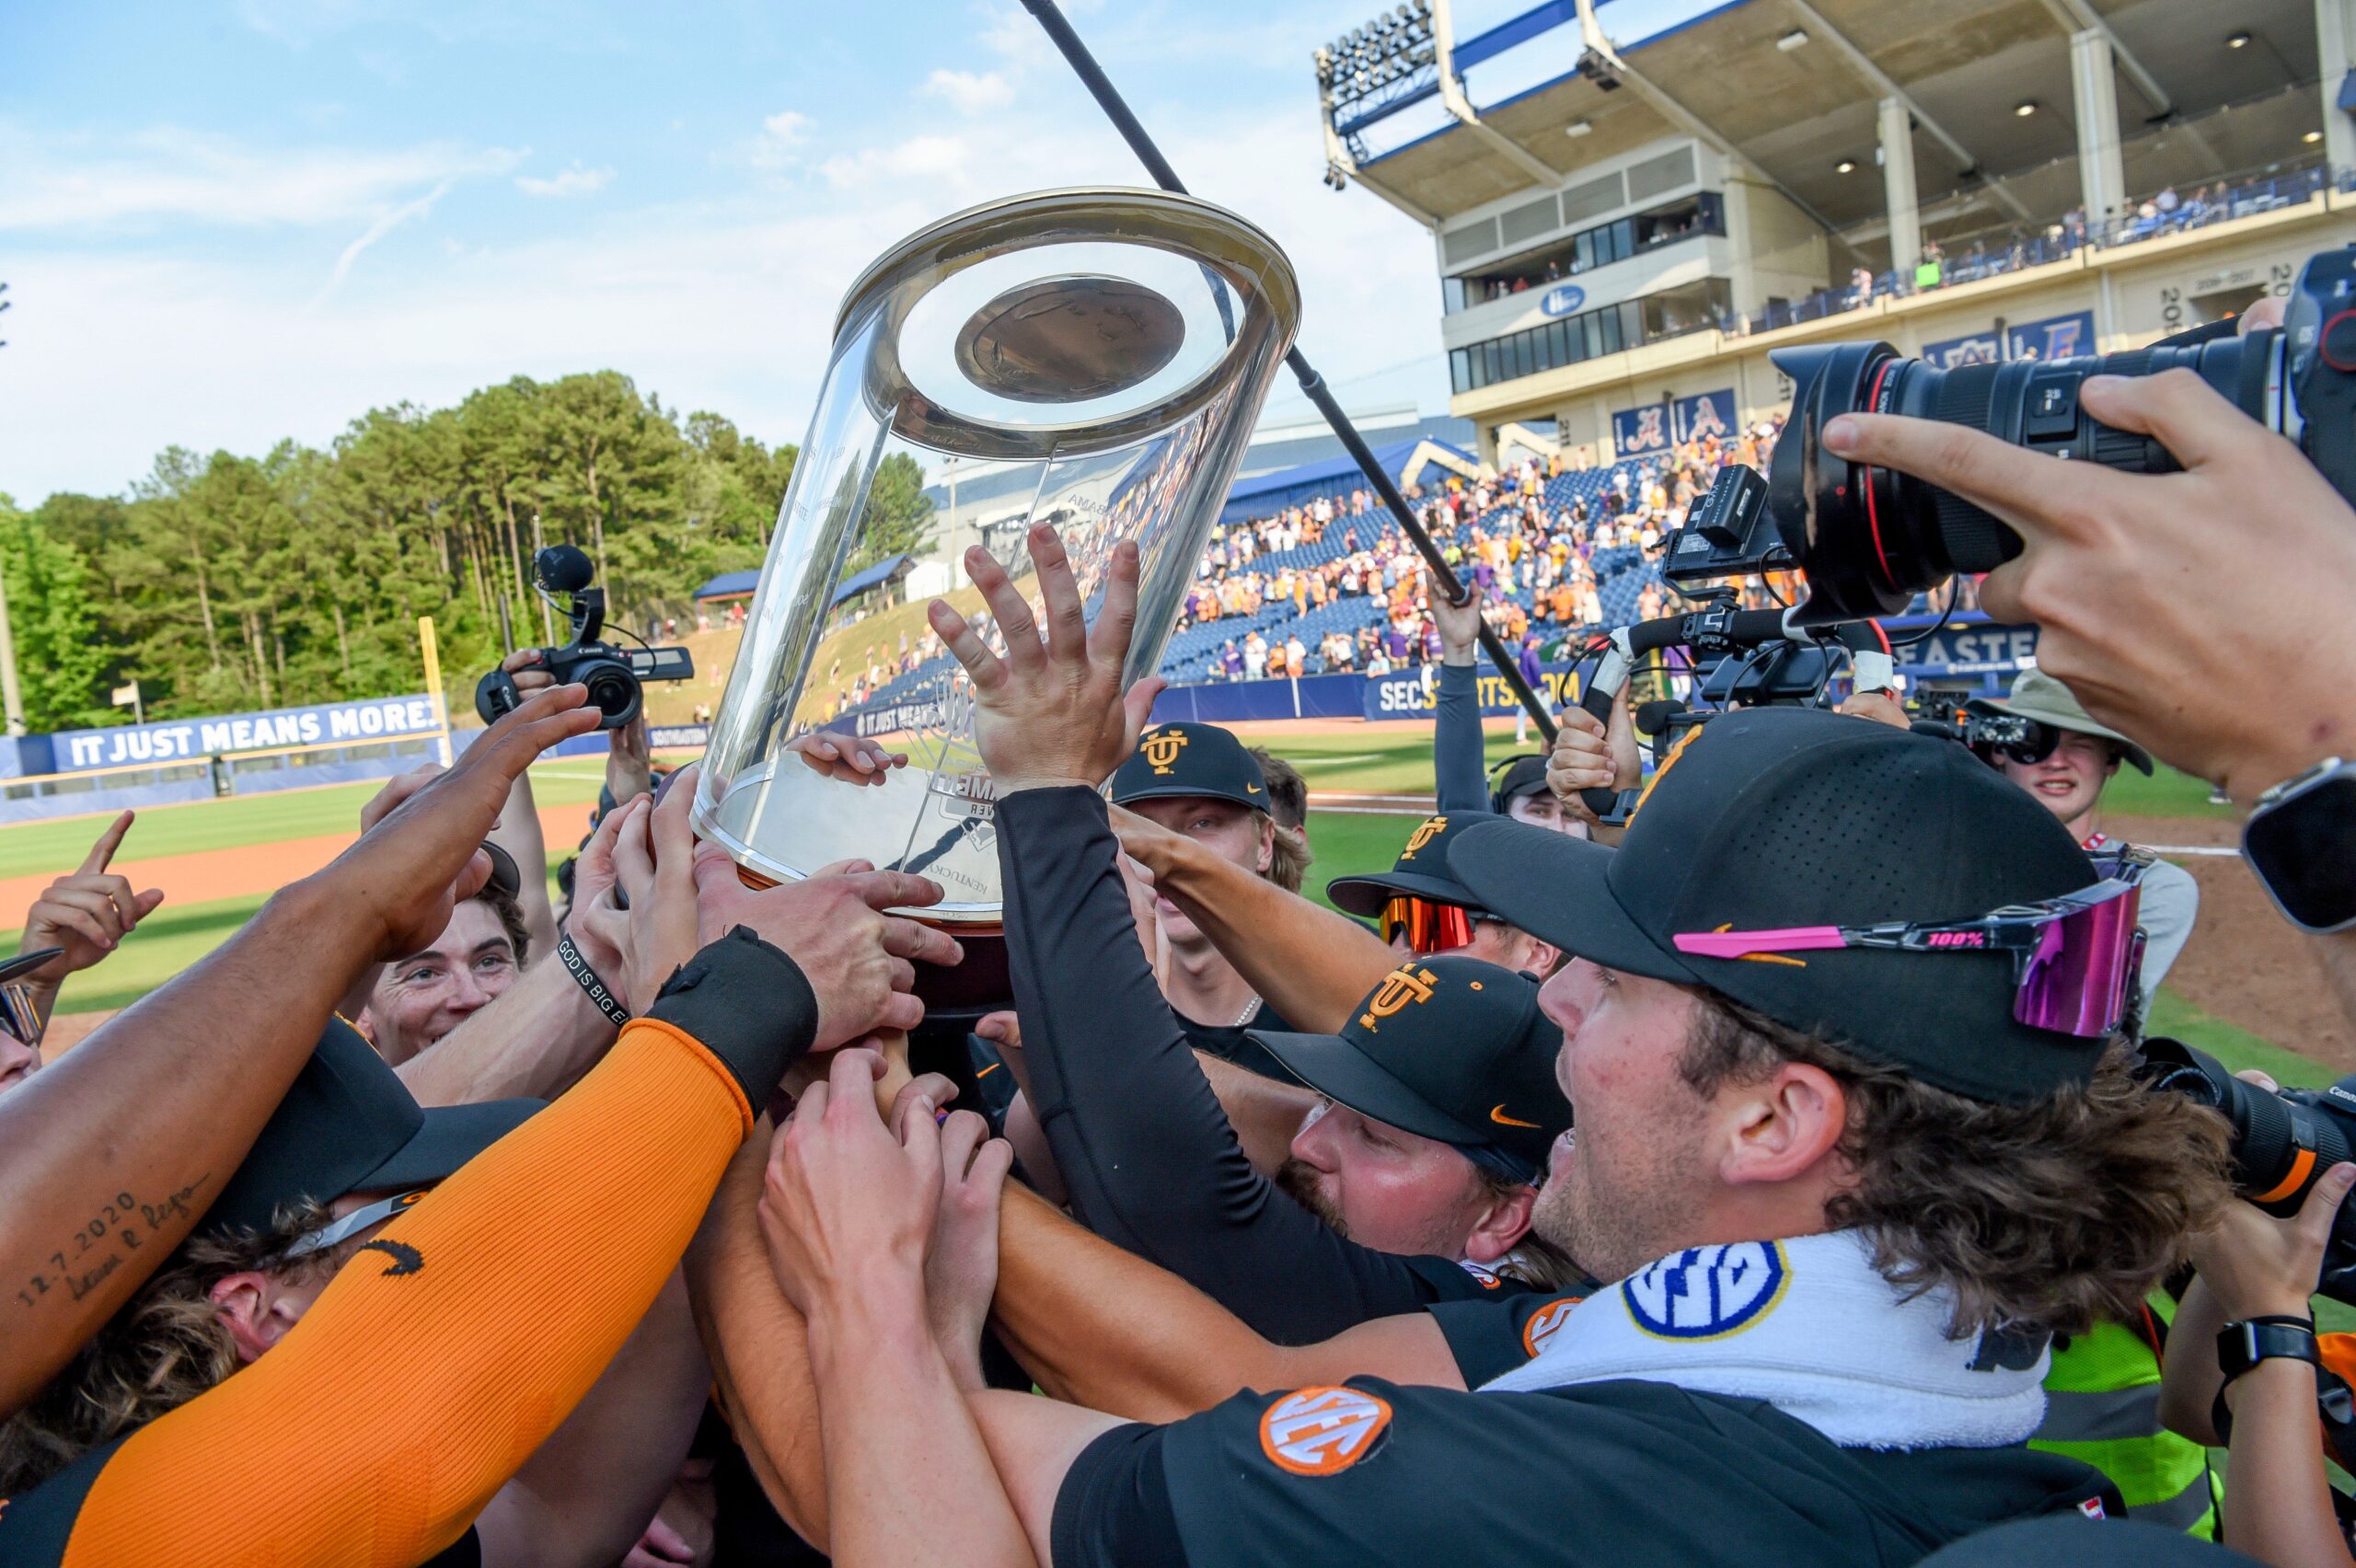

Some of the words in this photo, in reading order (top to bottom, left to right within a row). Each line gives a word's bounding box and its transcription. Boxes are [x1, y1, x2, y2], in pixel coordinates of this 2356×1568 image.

[70, 735, 106, 767] IT
[109, 726, 194, 763] JUST
[200, 712, 321, 753] MEANS
[1928, 931, 1984, 947] 100%
[559, 940, 581, 970] GOD
[576, 968, 594, 986] IS
[589, 985, 614, 1011] BIG
[1269, 1389, 1380, 1465] SEC
